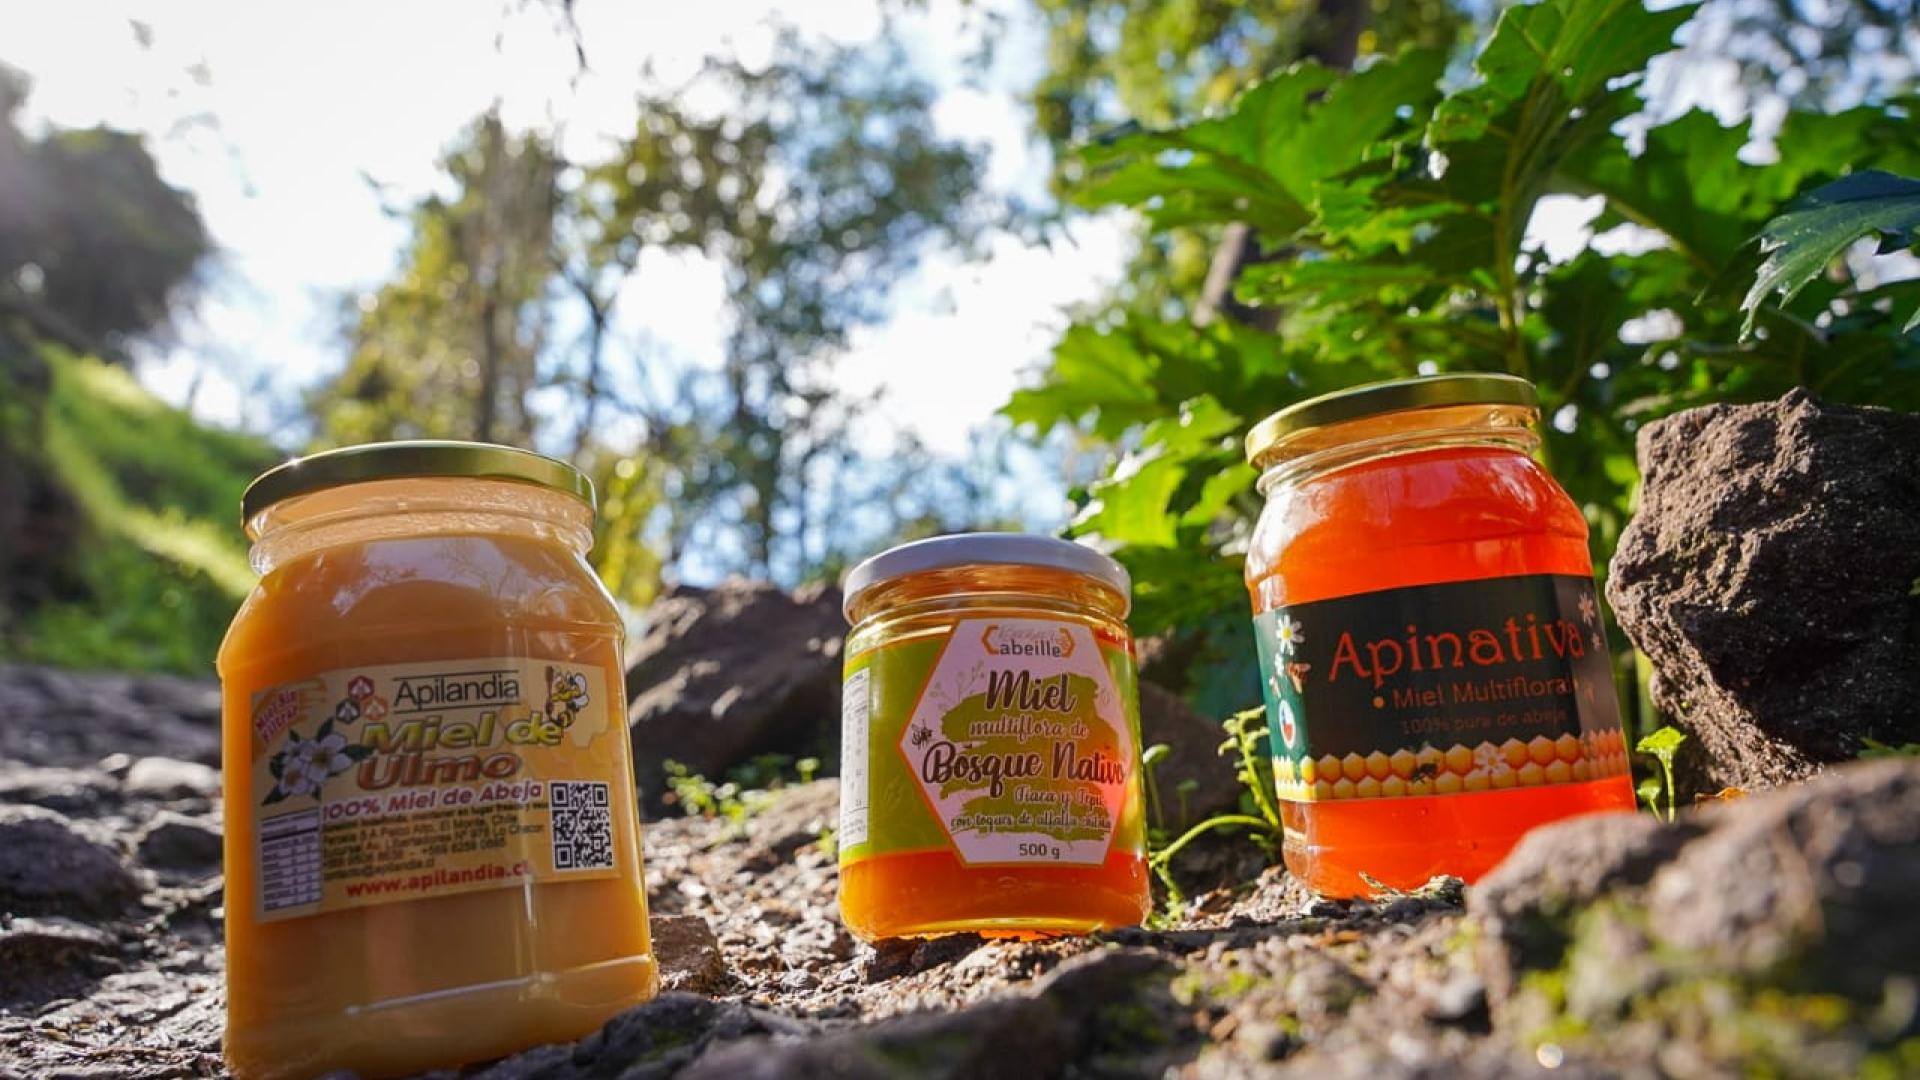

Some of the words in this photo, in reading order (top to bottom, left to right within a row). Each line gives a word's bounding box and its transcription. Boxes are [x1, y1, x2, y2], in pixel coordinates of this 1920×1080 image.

[1000, 639, 1061, 658] abeille
[1328, 612, 1586, 688] Apinativa
[393, 674, 520, 710] Apilandia
[986, 670, 1077, 713] Miel
[1392, 683, 1446, 709] Miel
[361, 711, 497, 753] Miel
[504, 710, 564, 747] de
[970, 716, 1064, 743] multiflora
[1071, 720, 1088, 738] de
[356, 751, 521, 791] Ulmo
[922, 741, 1044, 798] Bosque
[1052, 741, 1126, 785] Nativo
[323, 798, 381, 820] 100%
[388, 791, 436, 812] Miel
[443, 787, 473, 805] de
[479, 781, 542, 803] Abeja
[1019, 843, 1047, 857] 500
[1052, 846, 1061, 860] g
